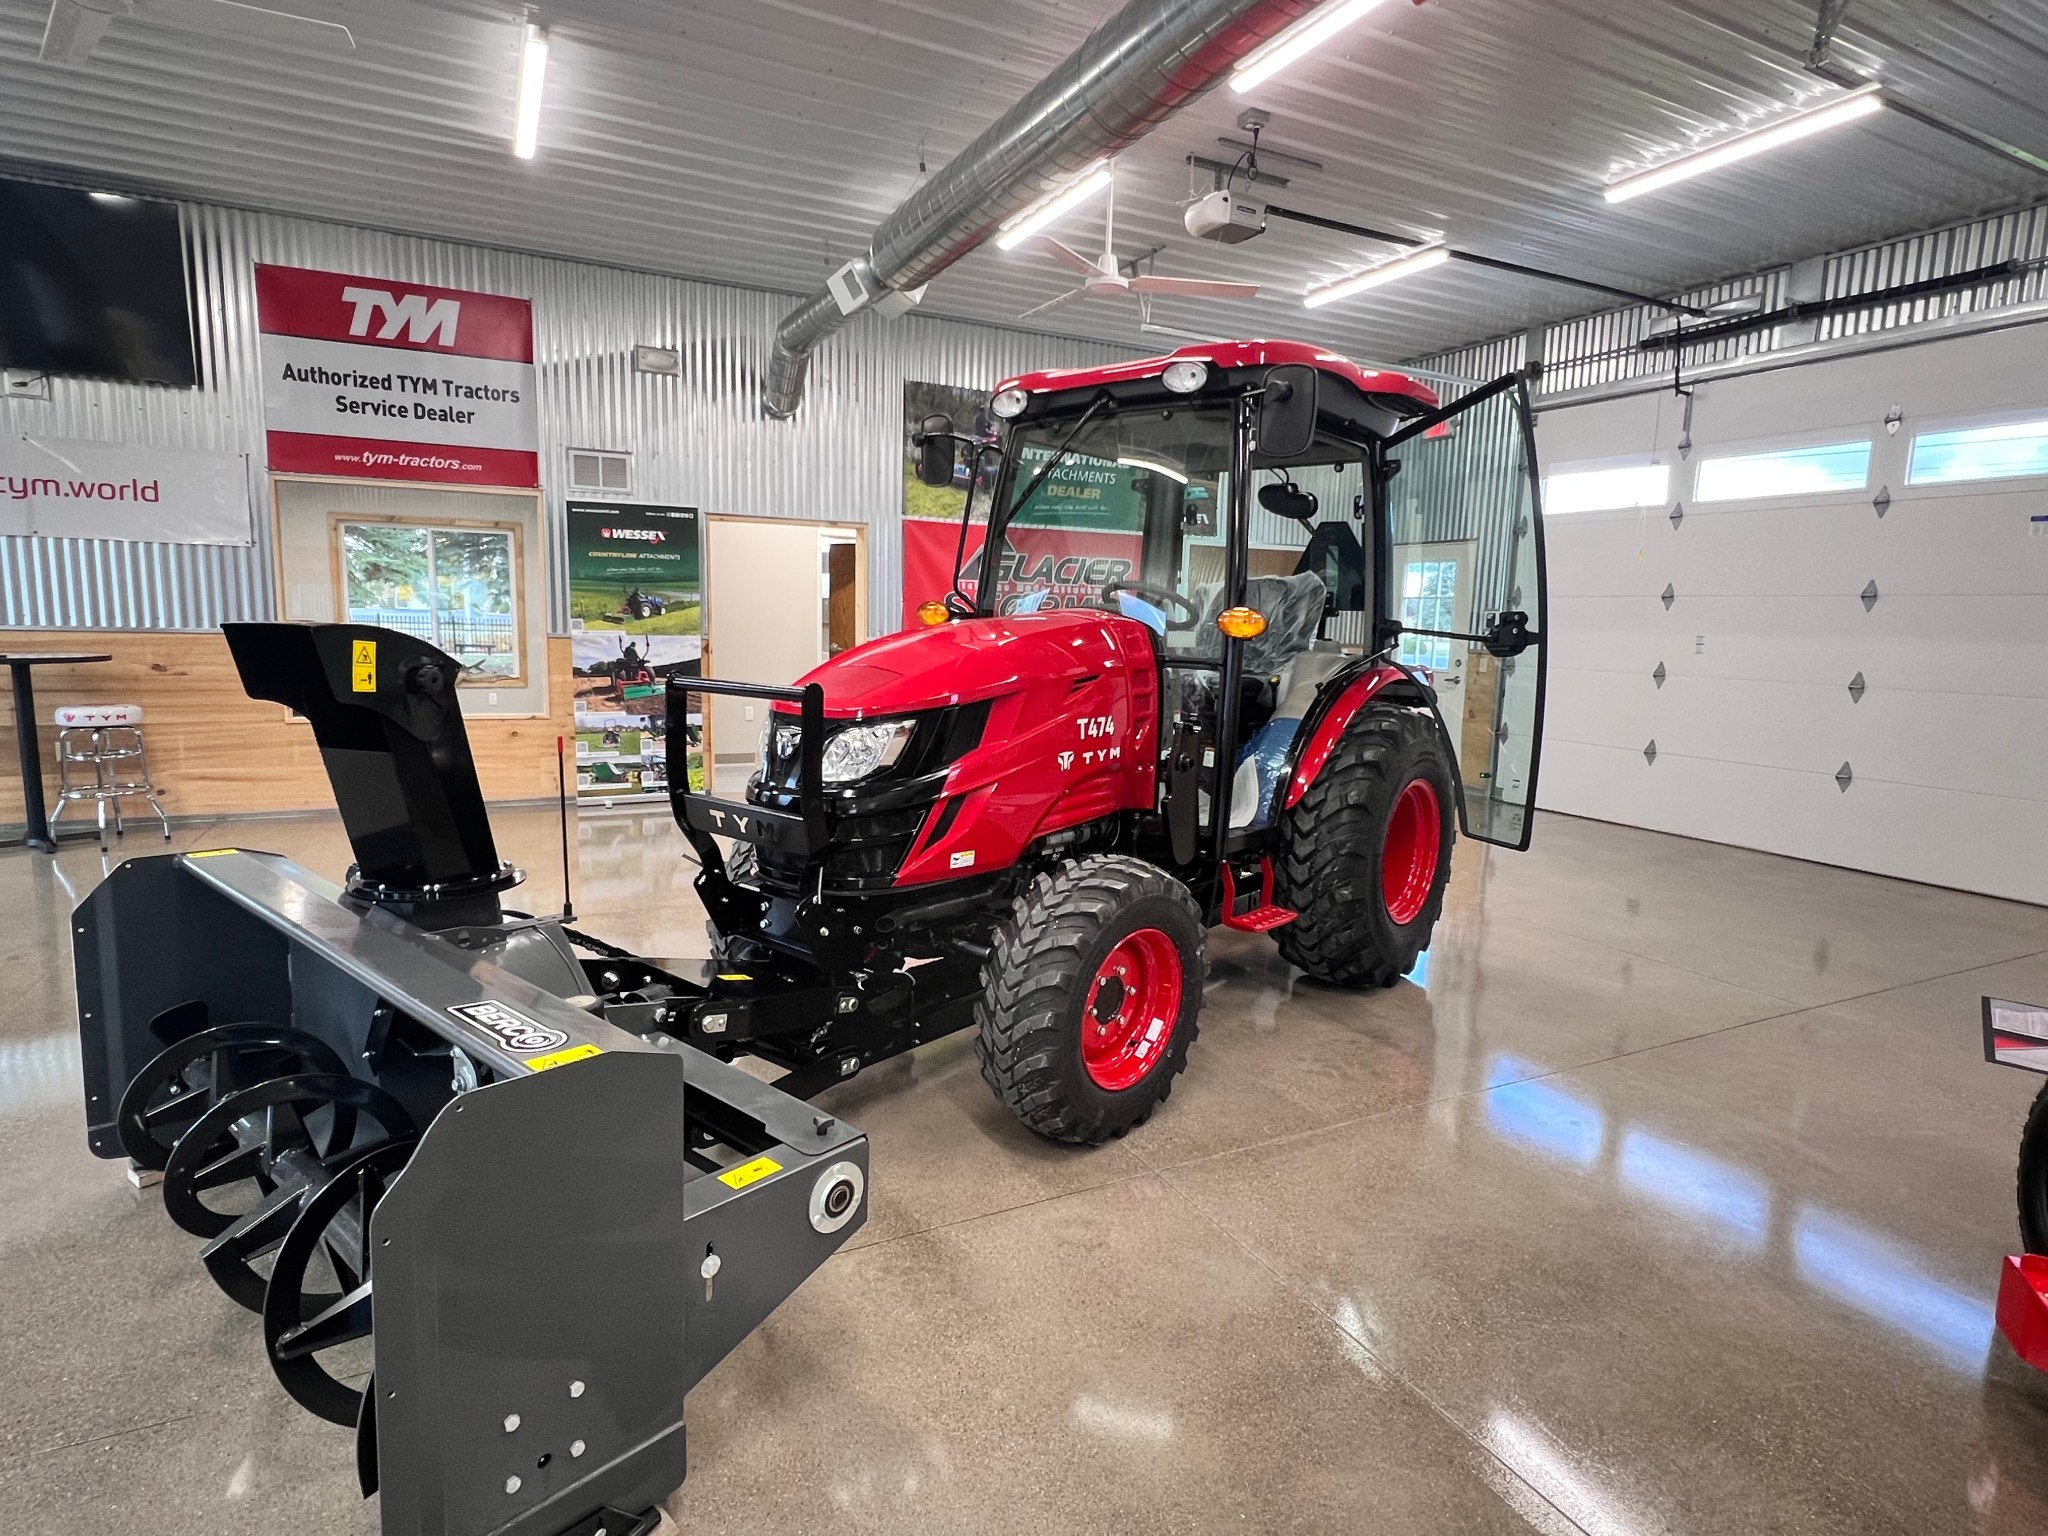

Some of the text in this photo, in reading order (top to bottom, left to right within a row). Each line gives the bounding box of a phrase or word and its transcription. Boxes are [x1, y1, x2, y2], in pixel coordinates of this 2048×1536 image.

[342, 286, 460, 347] TYM
[282, 363, 520, 403] Authorized TYM Tractors
[336, 395, 475, 424] Service Dealer
[334, 451, 482, 471] www.tym-tractors.com
[1047, 484, 1101, 500] DEALER
[612, 528, 666, 544] WESSEX
[638, 552, 681, 561] ATTACHMENTS
[84, 714, 127, 722] TYM
[1076, 715, 1115, 740] T474
[1082, 746, 1121, 764] TYM
[708, 808, 776, 842] TYM
[462, 1004, 556, 1049] BERCO
